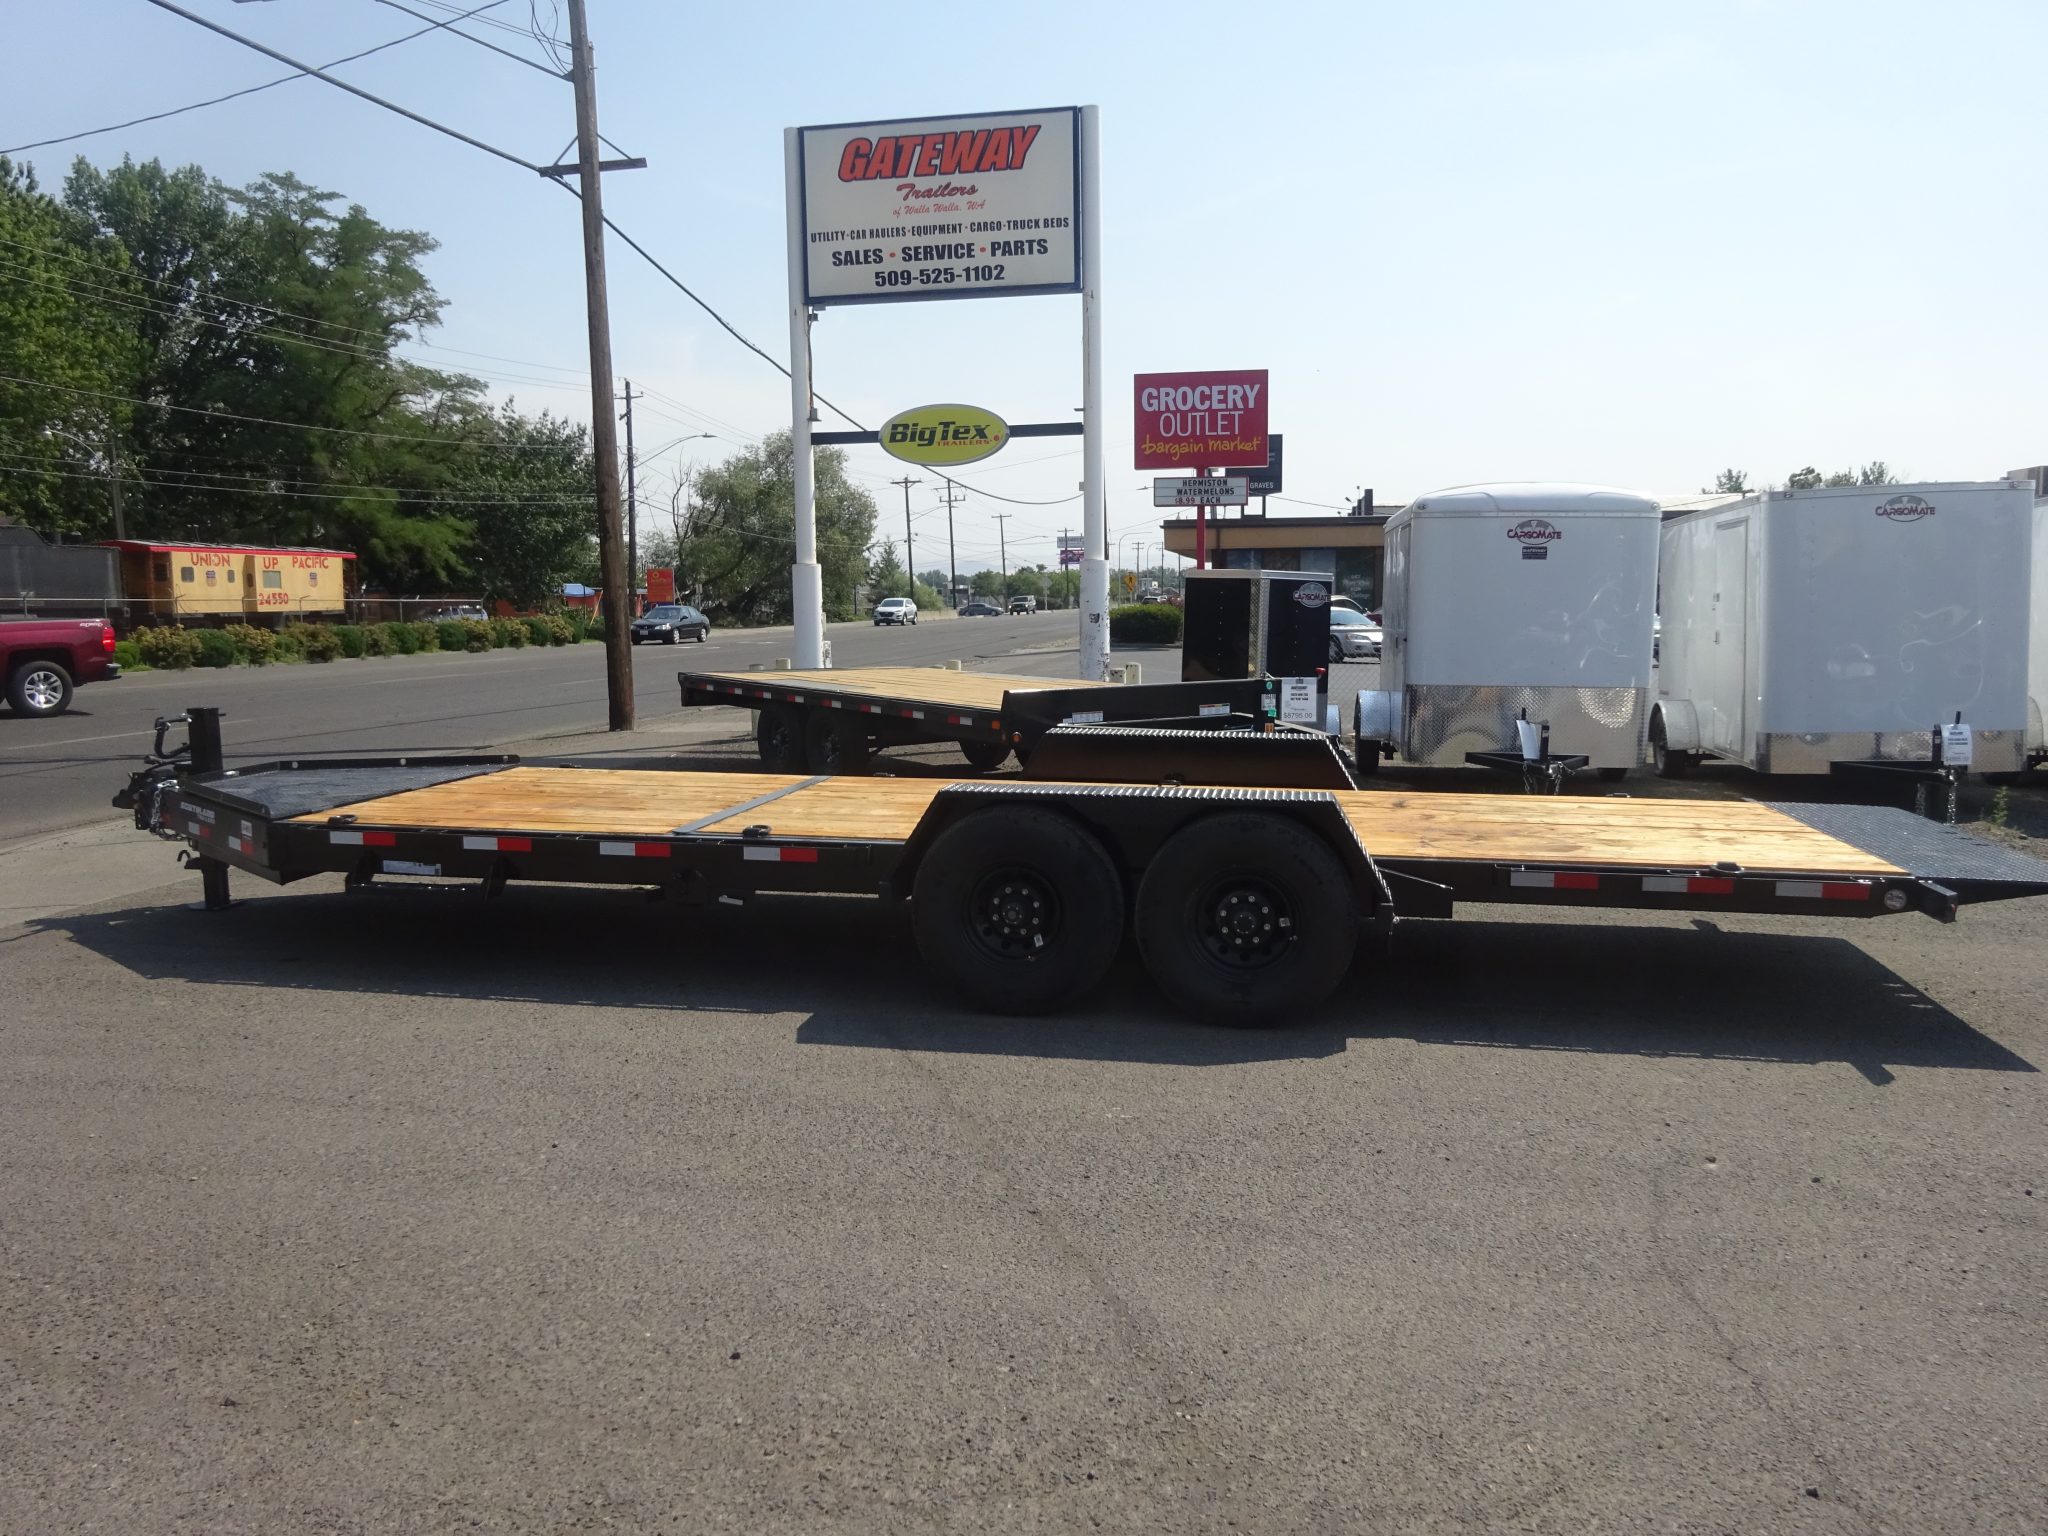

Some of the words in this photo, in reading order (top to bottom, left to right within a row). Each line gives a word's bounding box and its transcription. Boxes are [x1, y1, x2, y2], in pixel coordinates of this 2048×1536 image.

[838, 125, 1041, 182] GATEWAY
[896, 181, 978, 201] Trailers
[893, 206, 902, 218] of
[904, 204, 930, 215] Walla
[966, 200, 985, 210] WA
[811, 230, 845, 243] UTILITY
[850, 229, 867, 241] CAR
[869, 226, 906, 239] HAULERS
[911, 223, 963, 237] EQUIPMENT
[970, 220, 1002, 233] CARGO
[1007, 218, 1041, 231] TRUCK
[1043, 217, 1069, 228] BEDS
[832, 248, 884, 267] SALES
[901, 242, 976, 262] SERVICE
[990, 238, 1048, 257] PARTS
[874, 264, 1005, 287] 509-525-1102
[1141, 384, 1260, 412] GROCERY
[1159, 410, 1244, 437] OUTLET
[936, 439, 990, 447] TRAILERS
[1141, 434, 1204, 461] bargain
[1208, 436, 1261, 452] market
[1176, 488, 1235, 496] WATERMELONS
[1182, 479, 1228, 487] HERMISTON
[1200, 496, 1221, 504] EACH
[190, 553, 230, 567] UNION
[263, 557, 279, 569] UP
[292, 556, 329, 569] PACIFIC
[258, 592, 289, 606] 24550
